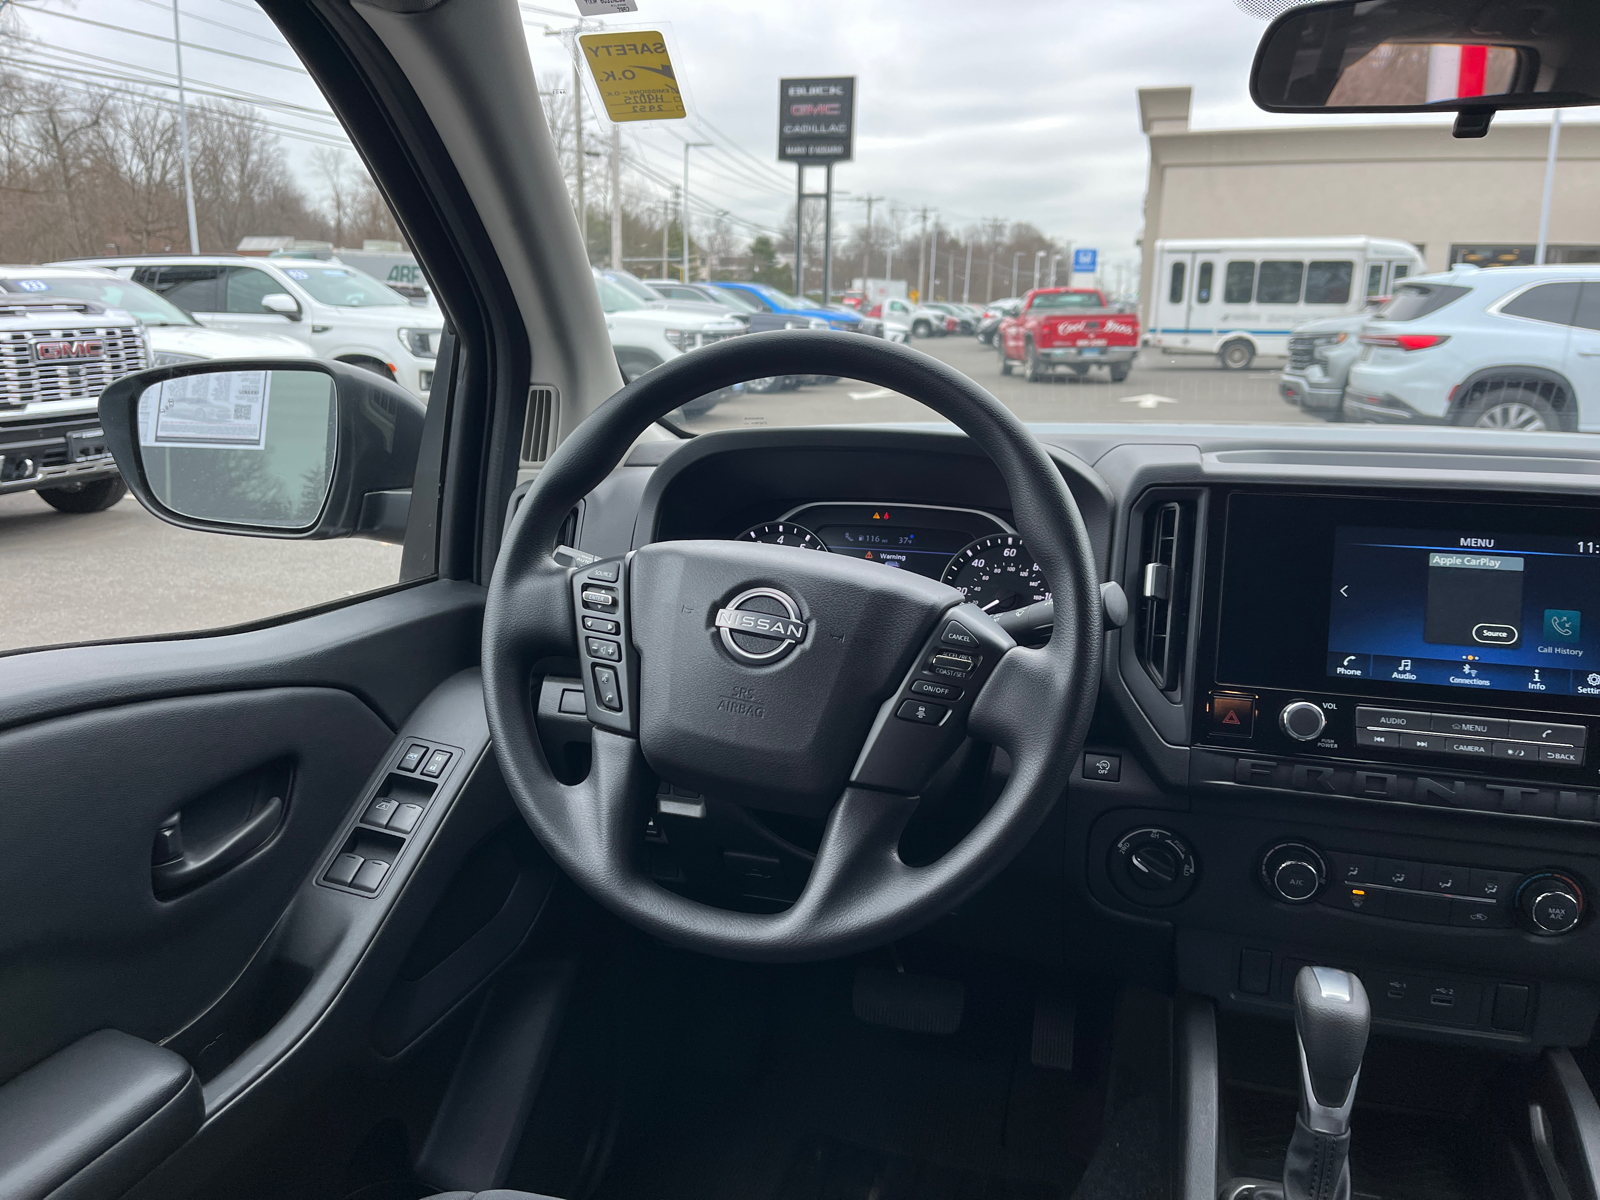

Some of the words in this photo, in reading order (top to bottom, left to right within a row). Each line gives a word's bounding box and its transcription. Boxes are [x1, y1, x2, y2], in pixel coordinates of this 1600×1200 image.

[788, 84, 844, 96] BUICK
[790, 103, 842, 116] GMC
[783, 122, 847, 134] CADILLAC
[37, 340, 103, 360] GMC
[776, 536, 784, 544] 4
[1460, 537, 1494, 548] MENU
[880, 553, 906, 562] Warning
[1003, 548, 1016, 557] 60
[972, 559, 984, 568] 40
[1433, 556, 1462, 566] Apple
[1464, 556, 1501, 568] CarPlay
[594, 570, 613, 578] SOURCE
[718, 612, 804, 638] NISSAN
[948, 633, 971, 642] CANCEL
[1482, 629, 1508, 638] Source
[1538, 646, 1553, 654] Call
[1555, 647, 1584, 658] History
[936, 668, 966, 678] COAST/SET
[1336, 666, 1362, 676] Phone
[1392, 671, 1416, 680] Audio
[1450, 676, 1490, 686] Connections
[923, 684, 949, 694] ON/OFF
[1528, 682, 1546, 691] Info
[732, 686, 756, 699] SRS
[717, 700, 766, 718] AIRBAG
[1380, 716, 1406, 726] AUDIO
[1462, 724, 1488, 733] MENU
[1454, 744, 1485, 754] CAMERA
[1554, 752, 1576, 761] BACK
